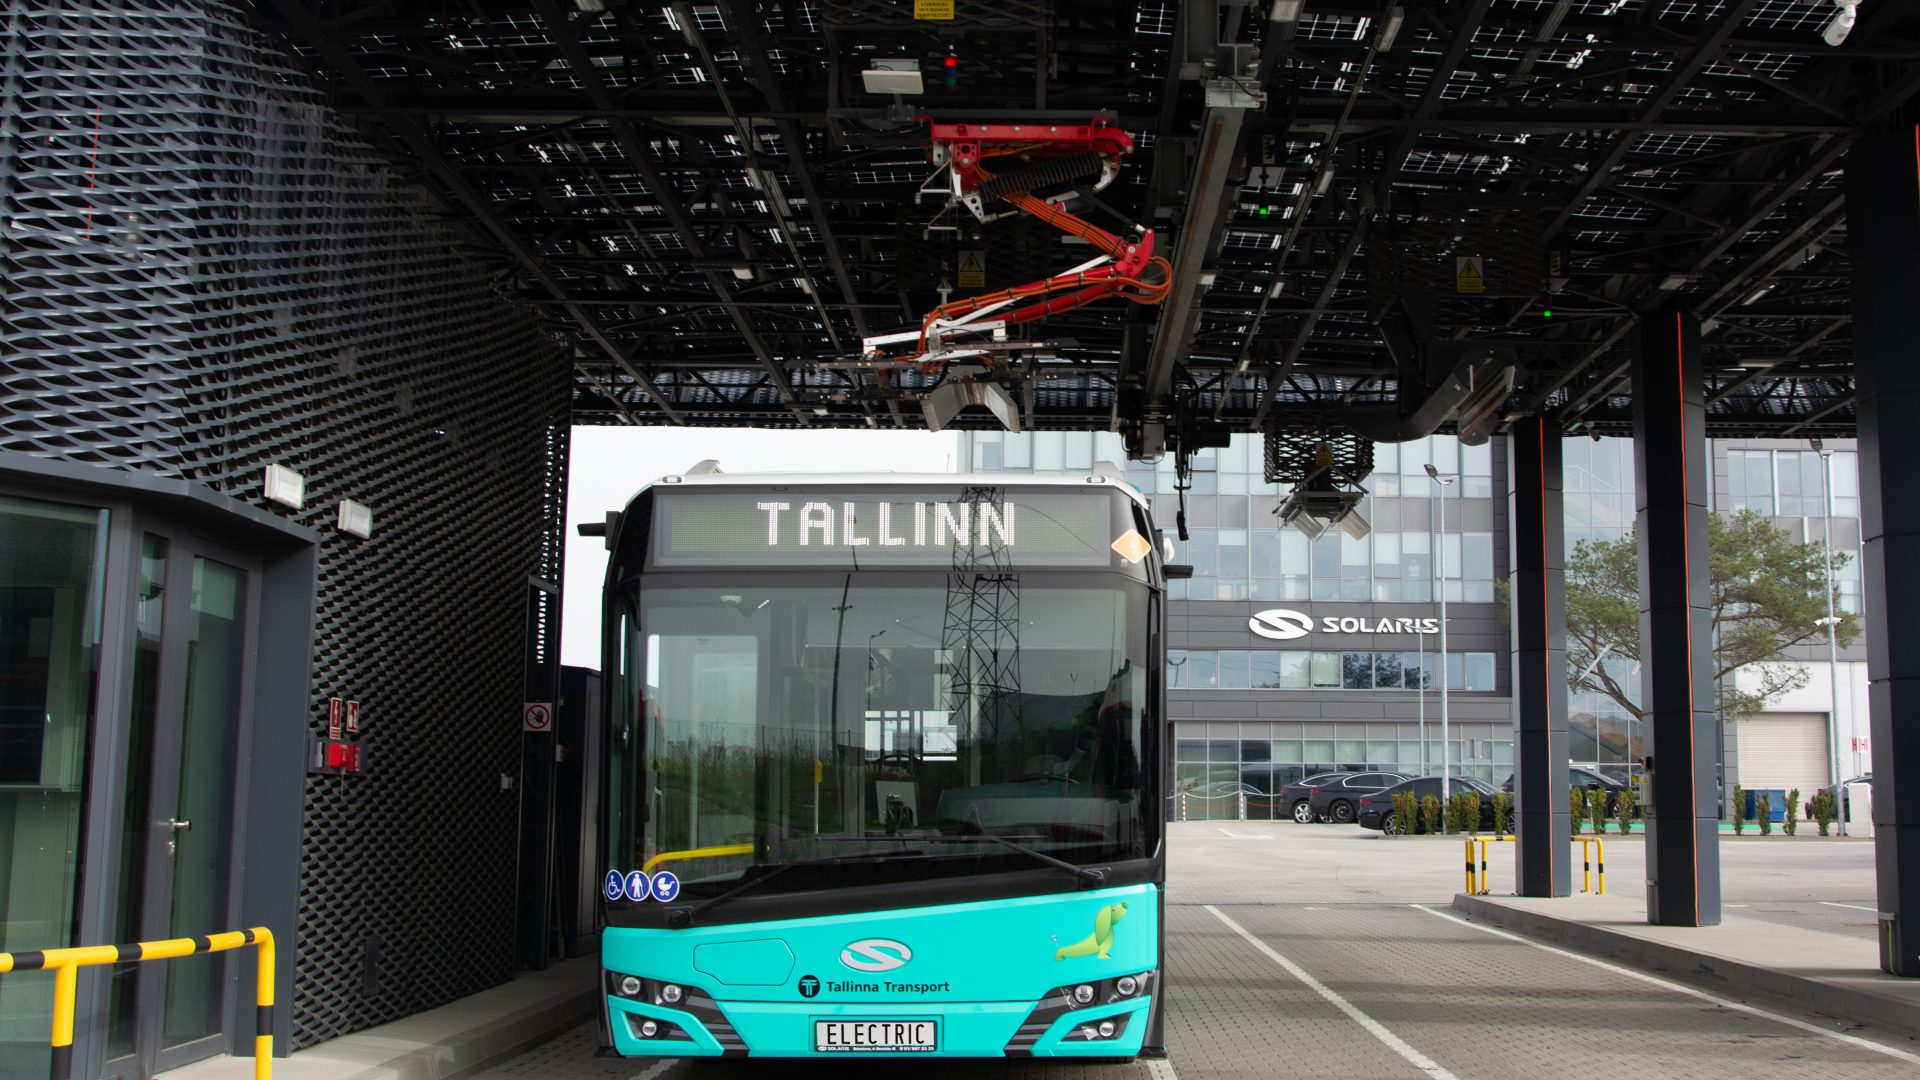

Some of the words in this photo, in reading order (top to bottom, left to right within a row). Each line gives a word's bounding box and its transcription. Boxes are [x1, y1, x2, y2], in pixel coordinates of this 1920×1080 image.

[757, 501, 1014, 546] TALLINN
[1322, 617, 1439, 634] SOLARIS
[826, 981, 879, 992] Tallinna
[884, 981, 950, 995] Transport
[827, 1023, 925, 1045] ELECTRIC
